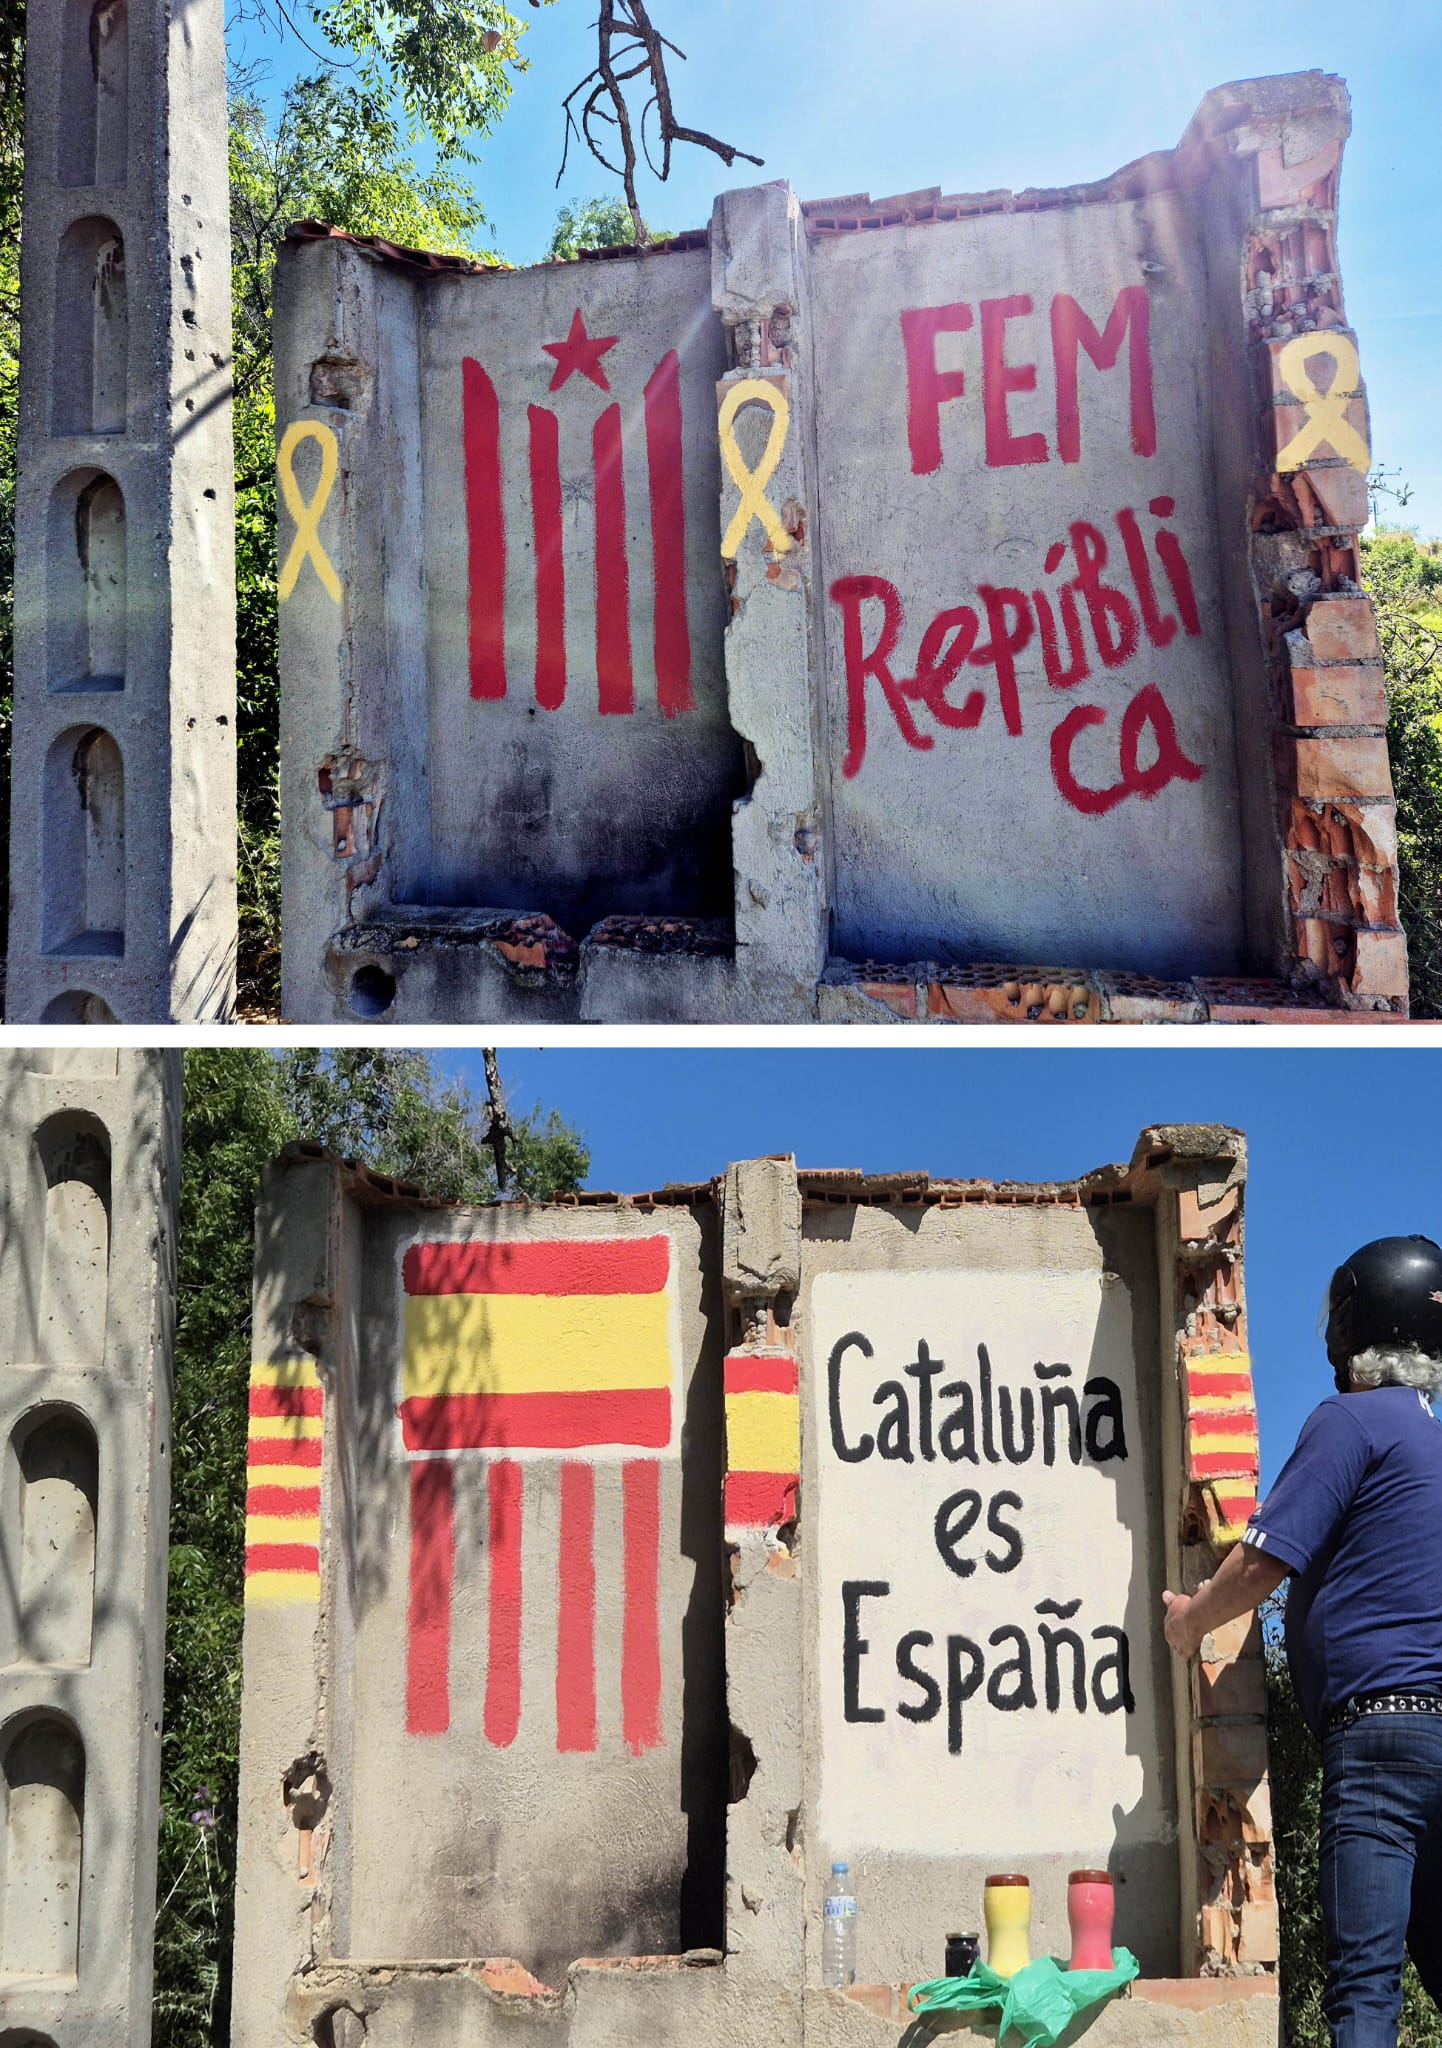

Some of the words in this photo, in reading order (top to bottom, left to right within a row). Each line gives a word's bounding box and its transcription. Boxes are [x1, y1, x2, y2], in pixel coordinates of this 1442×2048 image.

[901, 286, 1157, 475] FEM
[828, 1331, 1129, 1466] Cataluña
[934, 1488, 1024, 1578] es
[841, 1580, 1136, 1756] España
